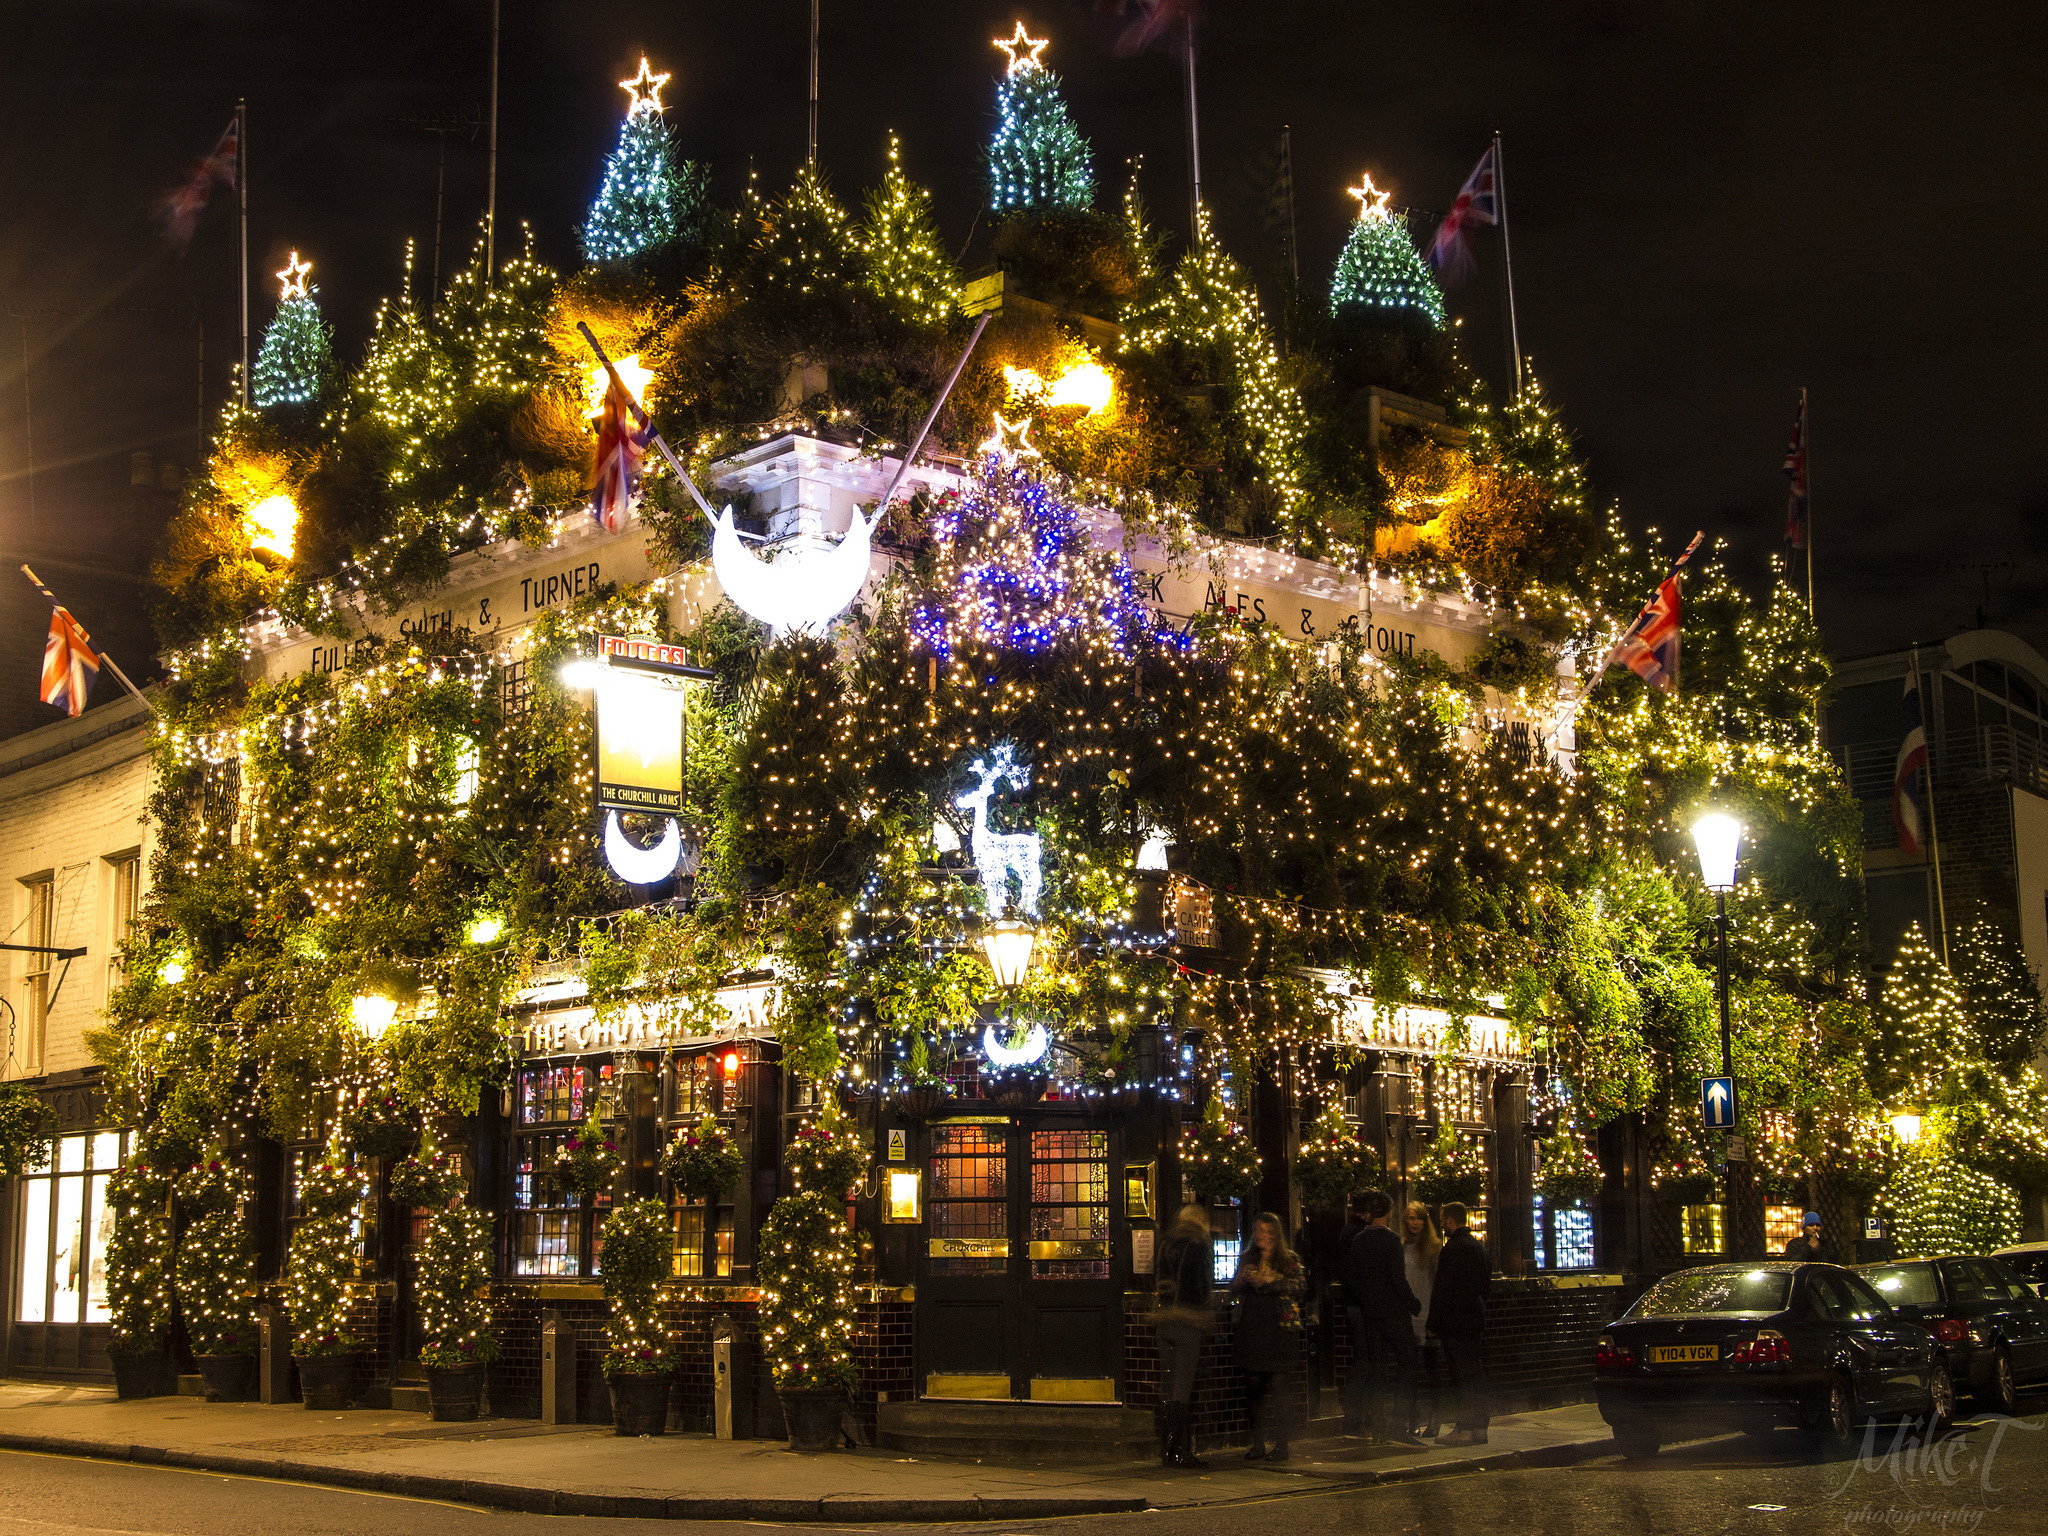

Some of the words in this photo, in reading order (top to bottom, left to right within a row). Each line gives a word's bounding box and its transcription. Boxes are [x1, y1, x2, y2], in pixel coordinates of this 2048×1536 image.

[312, 638, 373, 676] FULLE
[400, 609, 452, 639] SMITH
[479, 597, 492, 625] &
[520, 562, 600, 612] TURNER
[1301, 608, 1315, 636] &
[603, 637, 682, 666] FULLER'S
[601, 786, 616, 800] THE
[617, 788, 657, 804] CHURCHILL
[658, 793, 680, 806] ARMS
[1177, 928, 1212, 946] STREET
[522, 1021, 565, 1052] THE
[942, 1243, 996, 1253] CHURCHILL
[1055, 1245, 1083, 1255] ARMS
[1690, 1346, 1714, 1360] VGK
